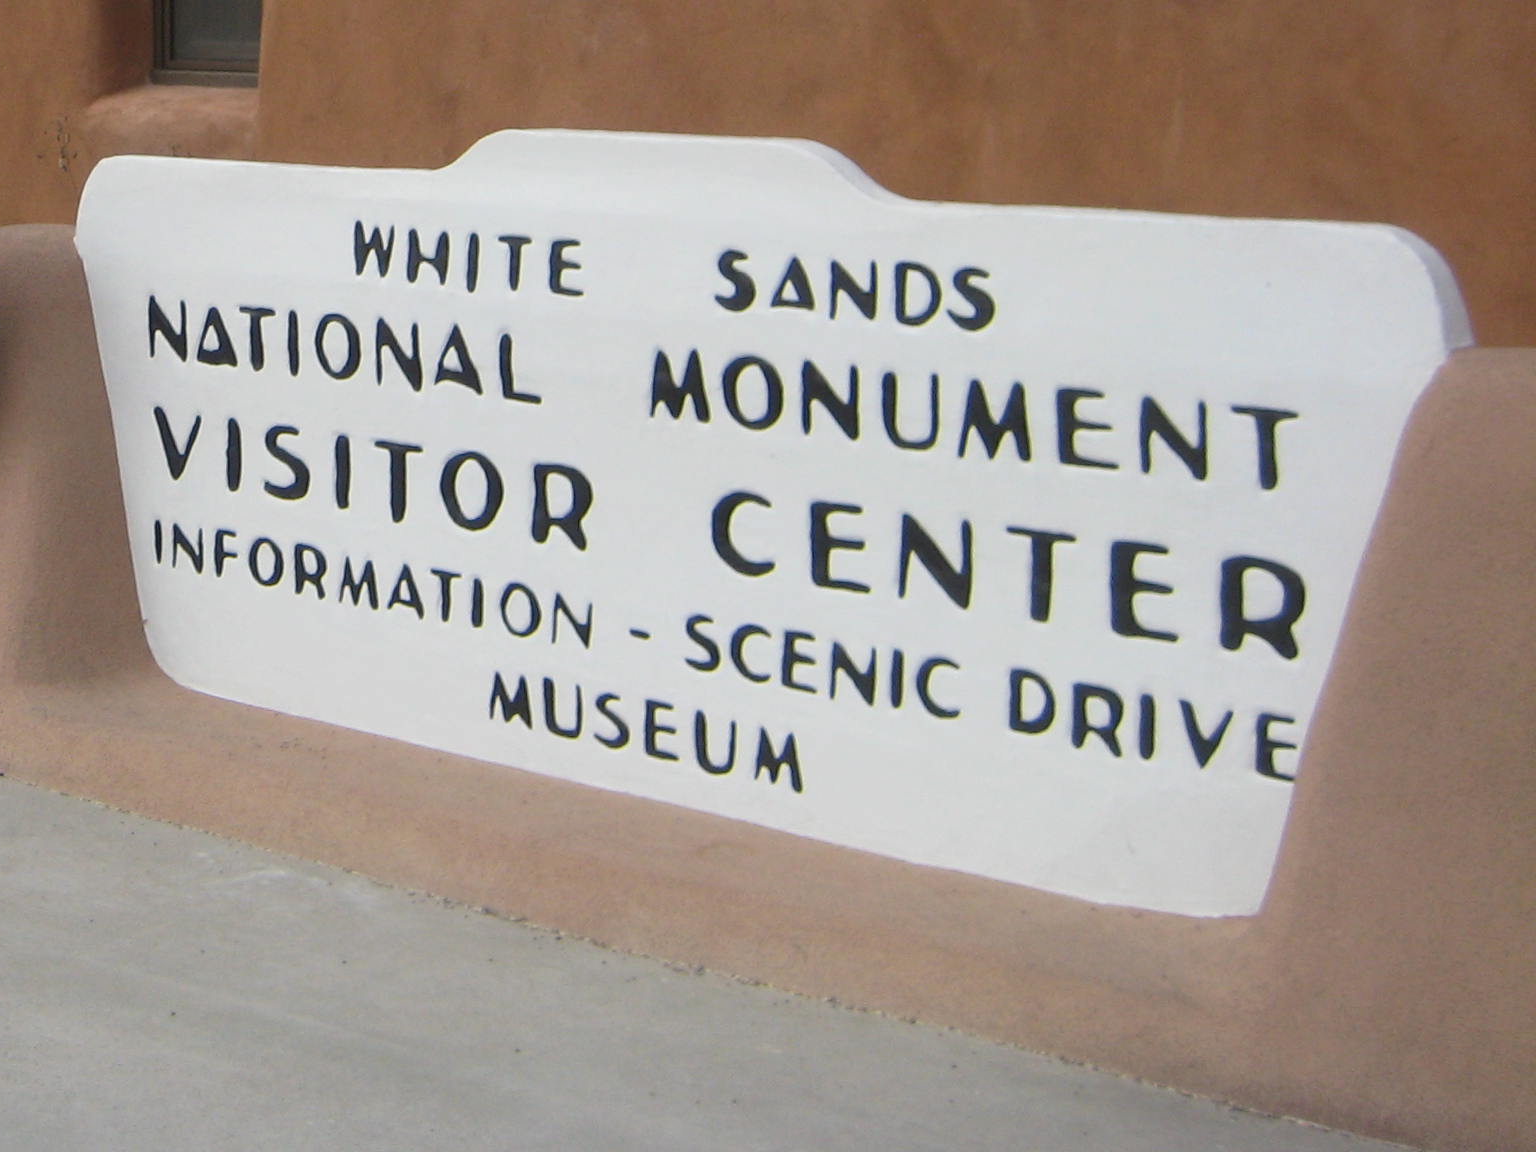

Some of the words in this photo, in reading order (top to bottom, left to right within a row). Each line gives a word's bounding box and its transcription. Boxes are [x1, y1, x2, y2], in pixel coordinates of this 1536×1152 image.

[353, 219, 584, 297] WHITE
[714, 249, 996, 332] SANDS
[147, 294, 543, 405] NATIONAL
[649, 348, 1299, 491] MONUMENT
[152, 405, 594, 552] VISITOR
[710, 490, 1307, 661] CENTER
[153, 518, 594, 649] INFORMATION
[684, 613, 961, 719] SCENIC
[1008, 668, 1298, 783] DRIVE
[488, 671, 804, 794] MUSEUM
